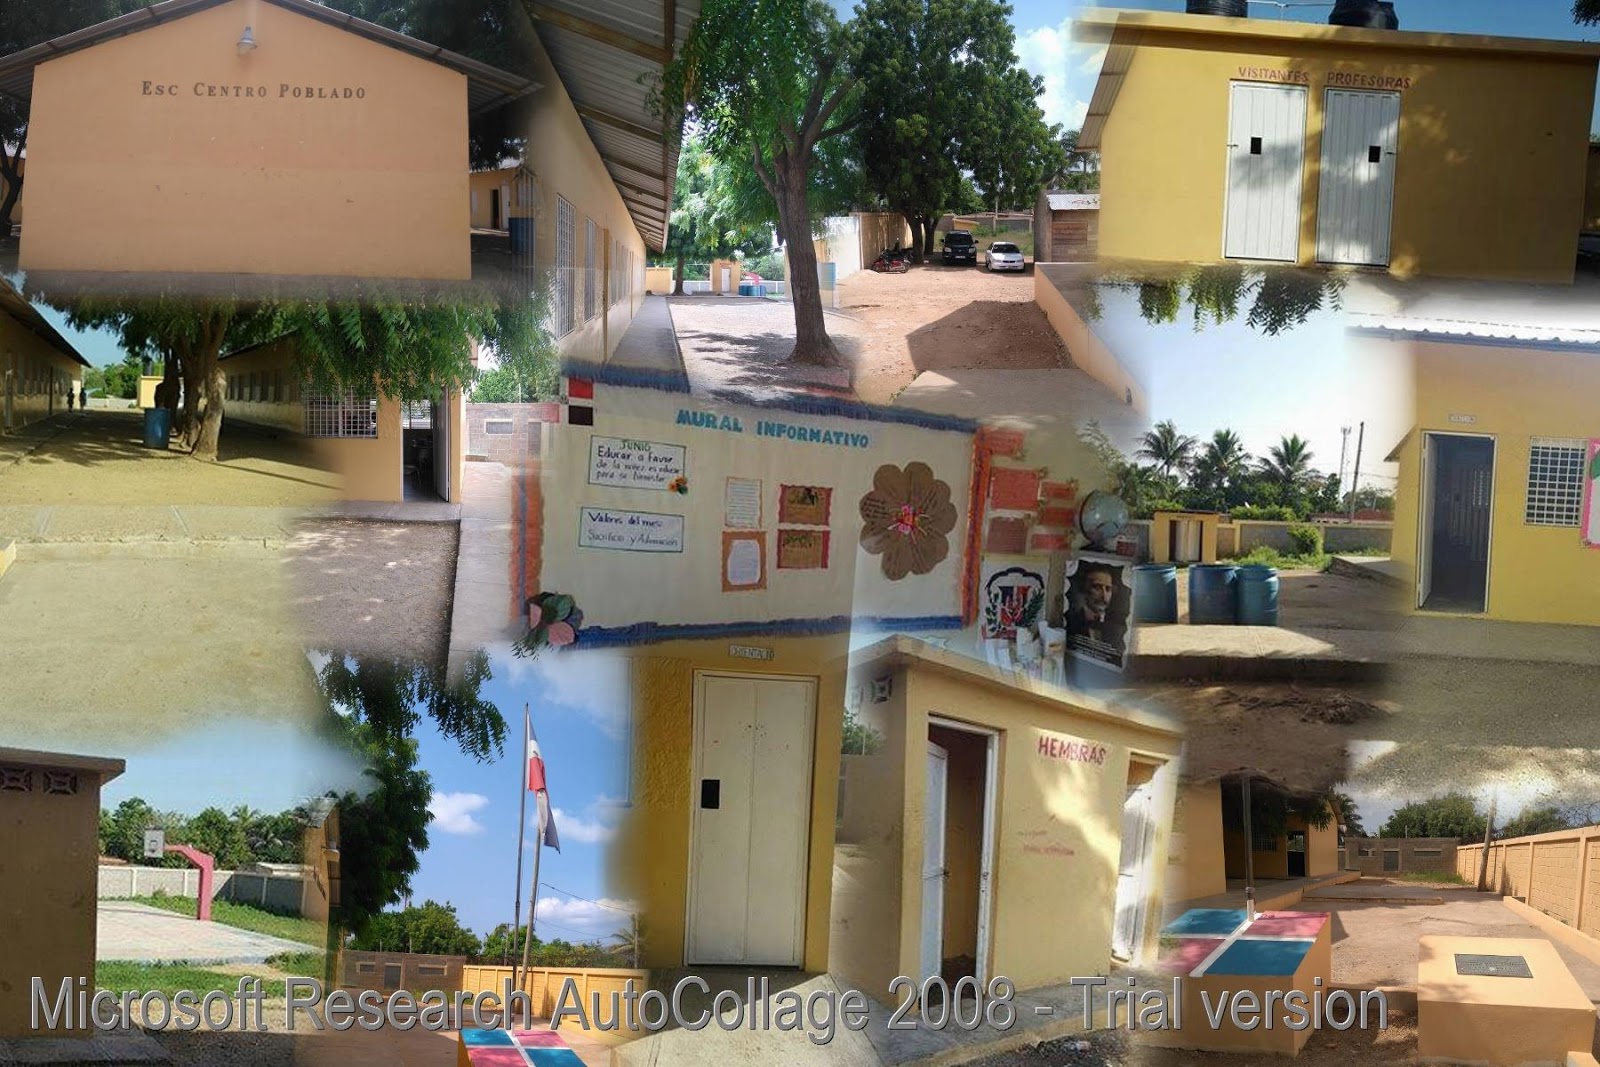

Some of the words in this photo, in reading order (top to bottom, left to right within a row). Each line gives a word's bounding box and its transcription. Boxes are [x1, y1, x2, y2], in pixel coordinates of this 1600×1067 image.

[1238, 66, 1309, 82] VISITANTES
[1327, 72, 1411, 89] PROFESORAS
[676, 409, 743, 433] MURAL
[757, 421, 870, 449] INFORMATIVO
[620, 440, 651, 452] JUNIO
[597, 445, 631, 460] Educar
[638, 453, 645, 462] a
[648, 451, 674, 464] favor
[596, 459, 608, 470] de
[613, 459, 621, 470] la
[596, 471, 615, 480] para
[1038, 735, 1106, 765] HEMBRAS
